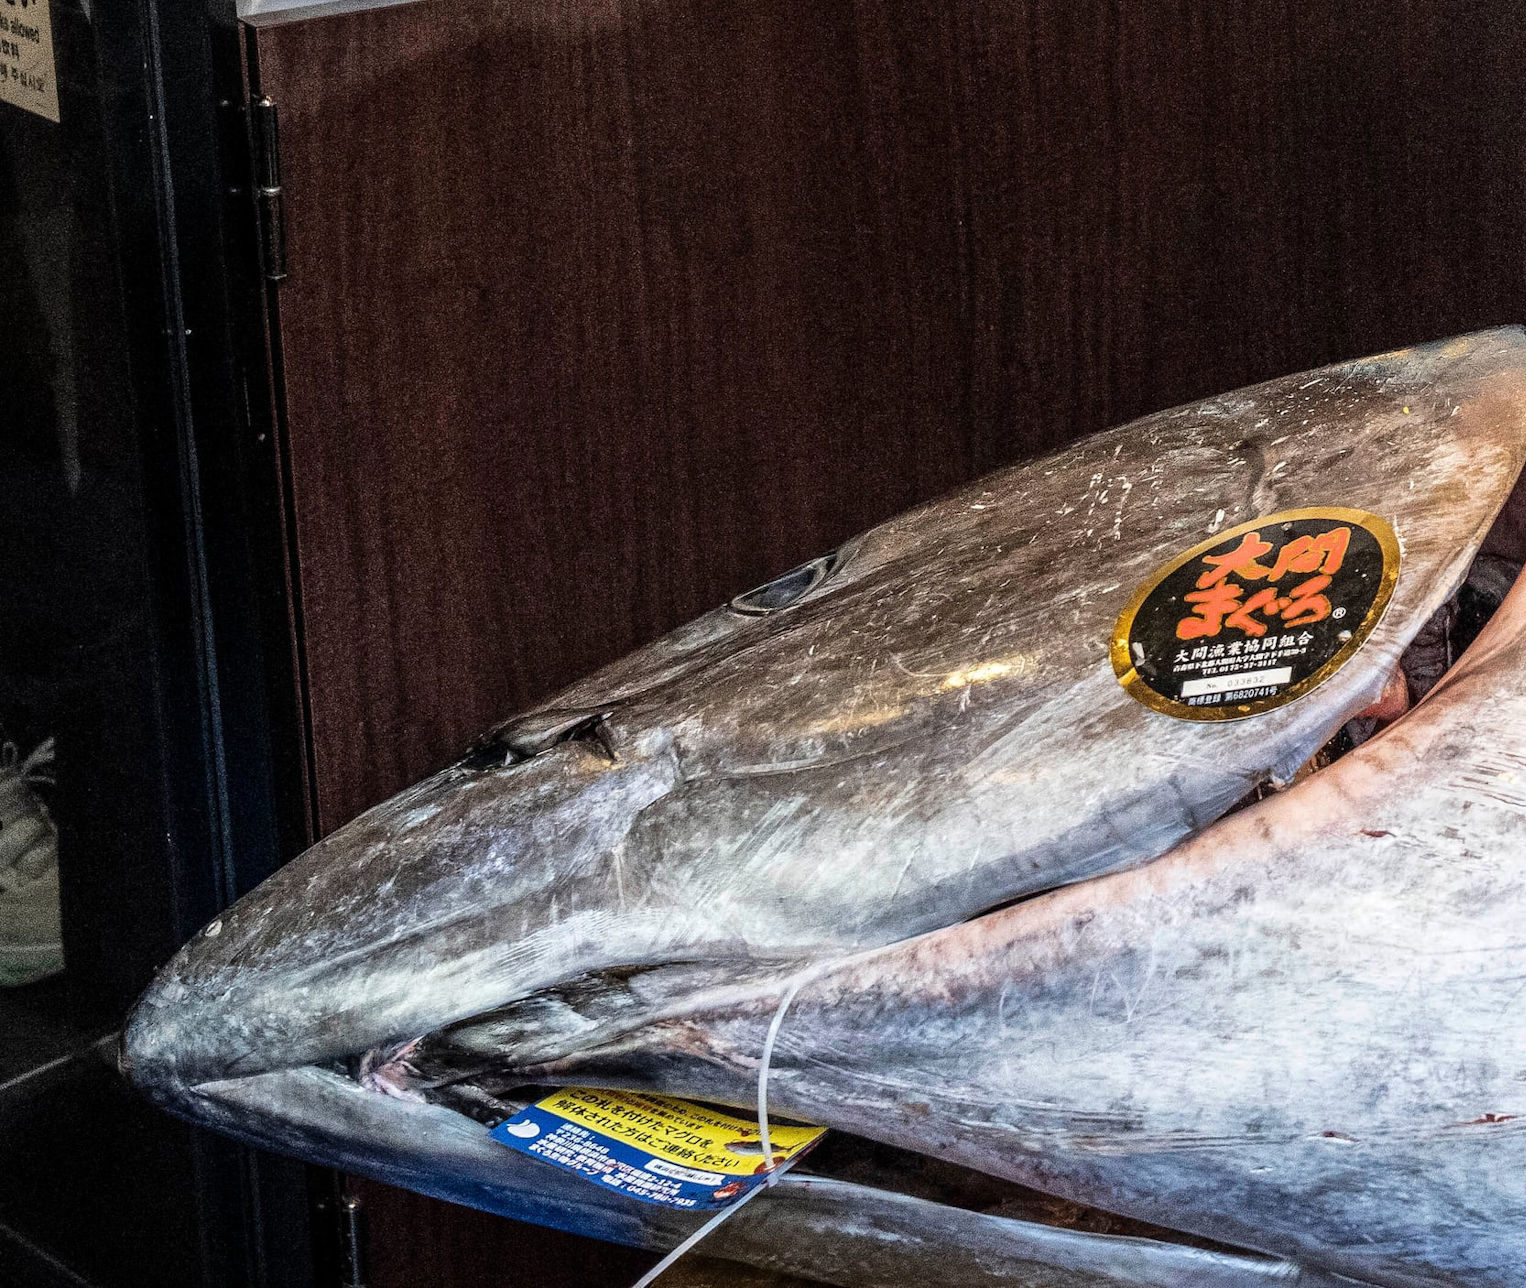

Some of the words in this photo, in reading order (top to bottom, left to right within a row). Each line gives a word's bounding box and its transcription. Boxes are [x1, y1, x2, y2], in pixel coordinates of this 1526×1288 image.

[1195, 526, 1352, 590] 大間
[1173, 630, 1314, 663] 大間漁業協同組合
